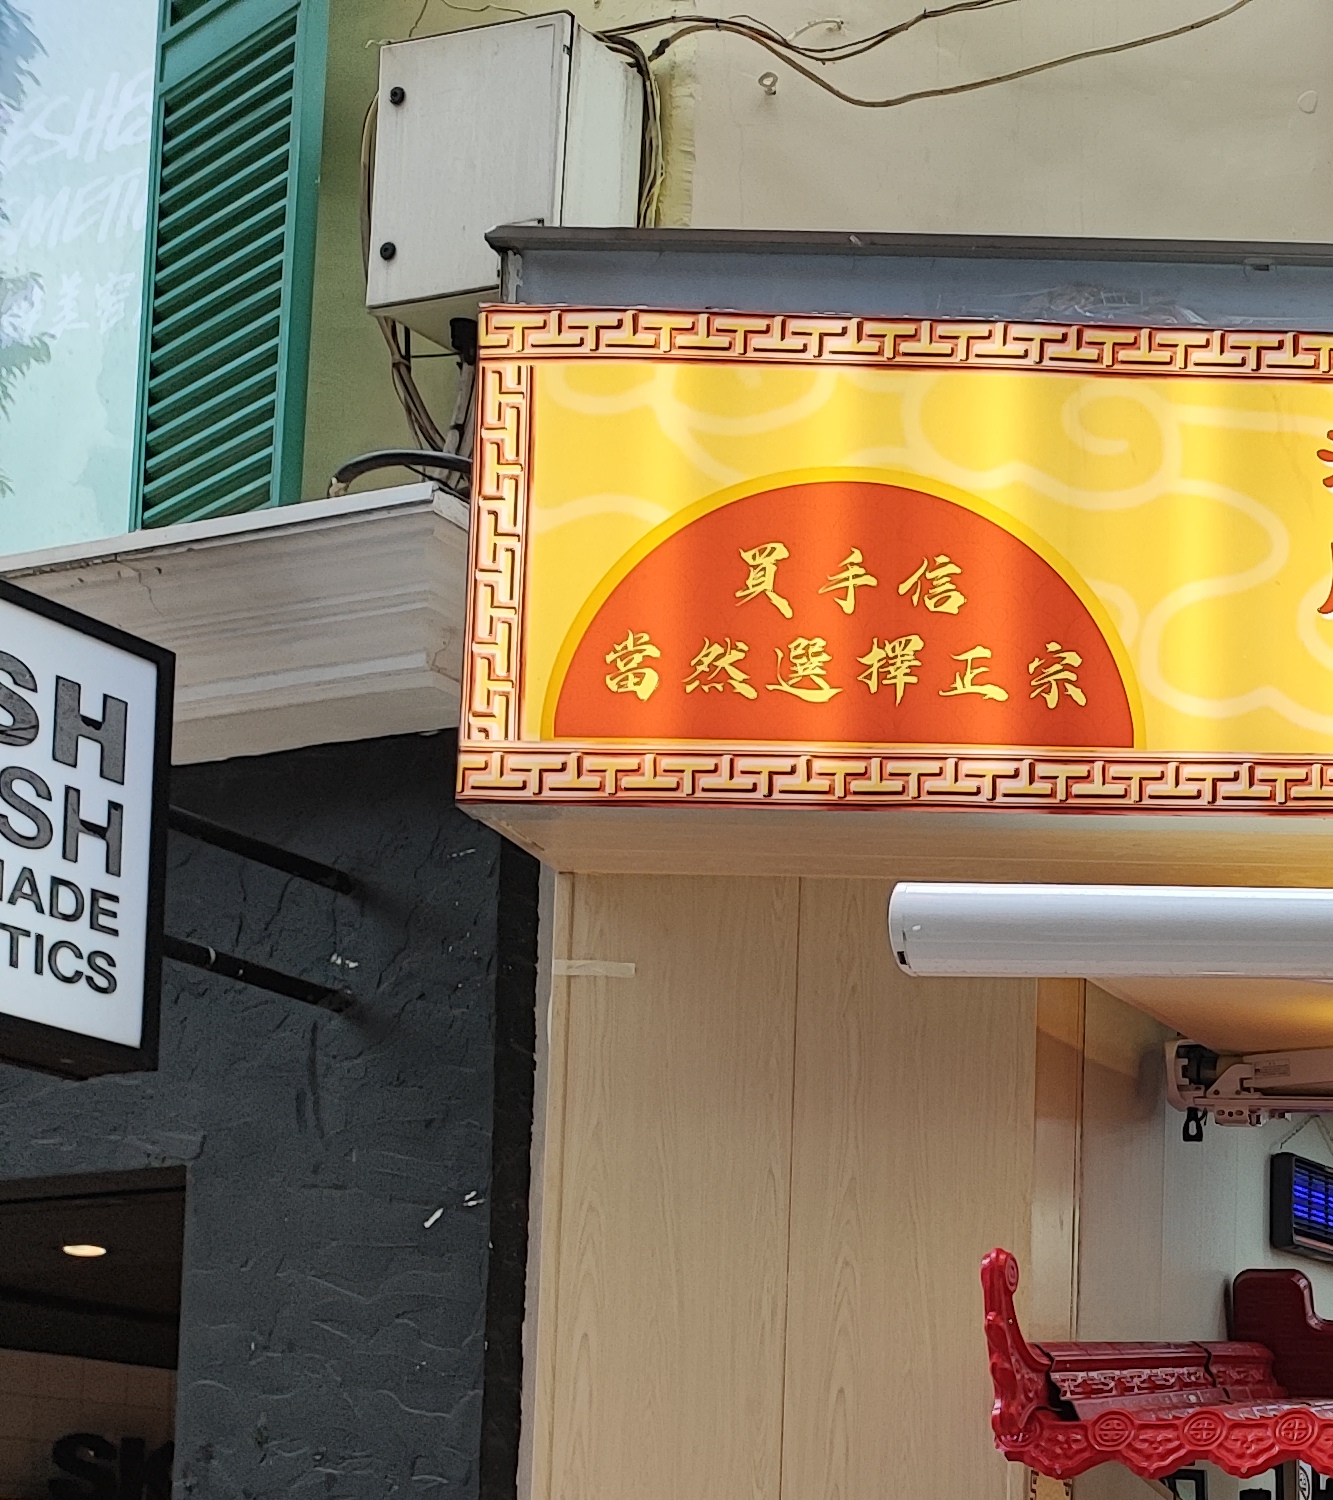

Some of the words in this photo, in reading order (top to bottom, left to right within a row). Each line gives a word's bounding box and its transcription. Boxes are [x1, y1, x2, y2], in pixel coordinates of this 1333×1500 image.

[734, 542, 966, 618] 買手信
[604, 629, 1088, 709] 當然選擇正宗
[0, 765, 123, 877] SH
[0, 860, 119, 937] ADE
[0, 922, 117, 995] TICS
